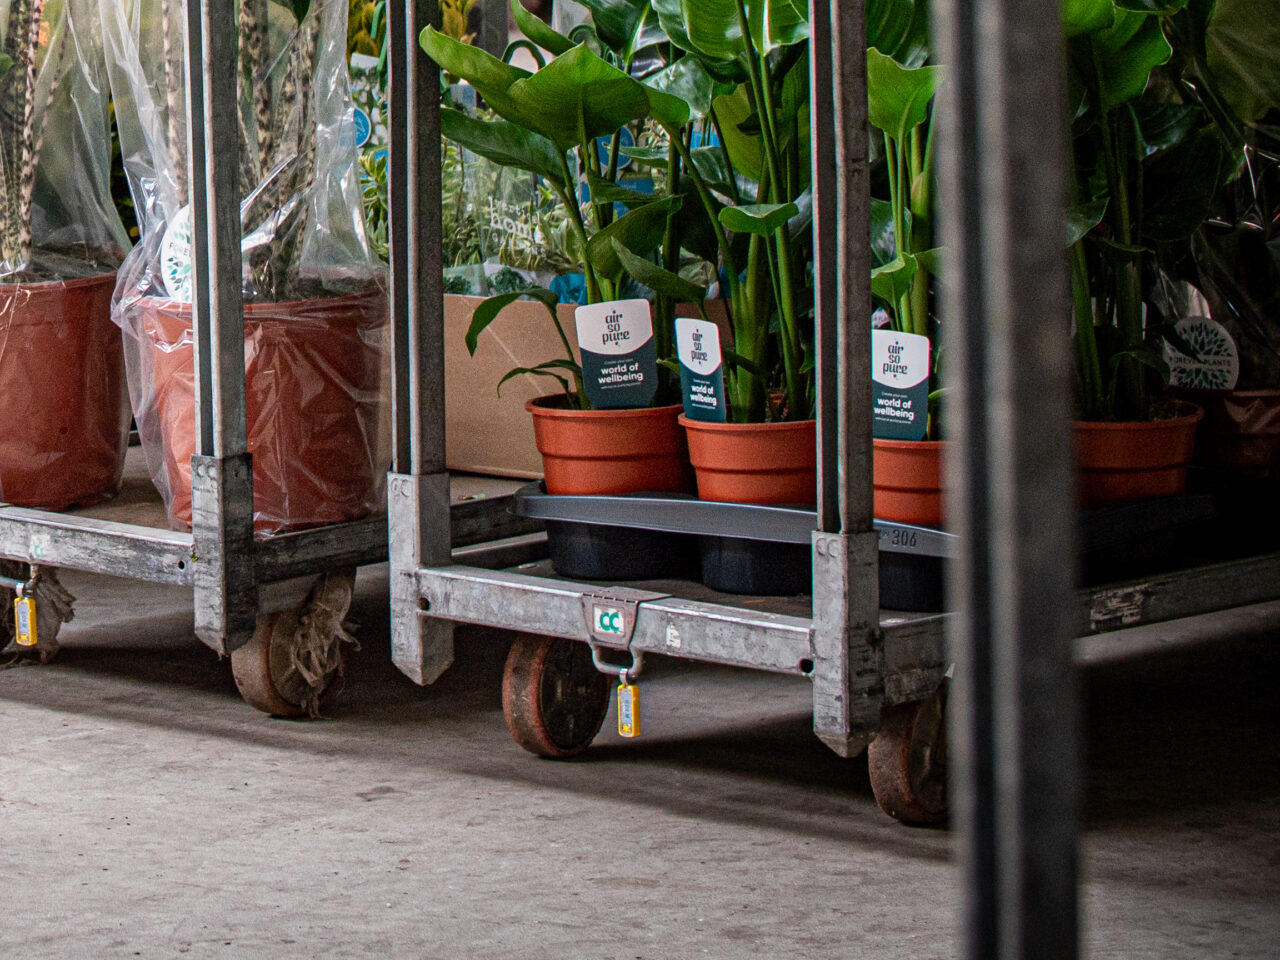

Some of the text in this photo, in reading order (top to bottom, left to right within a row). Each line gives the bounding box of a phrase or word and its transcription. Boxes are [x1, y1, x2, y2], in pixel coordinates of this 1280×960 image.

[605, 310, 623, 324] air
[607, 323, 621, 332] so
[602, 330, 630, 345] pure
[692, 328, 703, 342] air
[694, 342, 702, 351] so
[888, 341, 904, 354] air
[691, 351, 708, 362] pure
[889, 354, 900, 363] so
[601, 362, 639, 374] world of
[883, 362, 907, 374] pure
[598, 372, 644, 384] wellbeing
[691, 385, 714, 394] world of
[690, 393, 717, 406] wellbeing
[877, 398, 912, 408] world of
[873, 407, 915, 420] wellbeing
[892, 529, 917, 547] 306
[600, 611, 620, 632] CC
